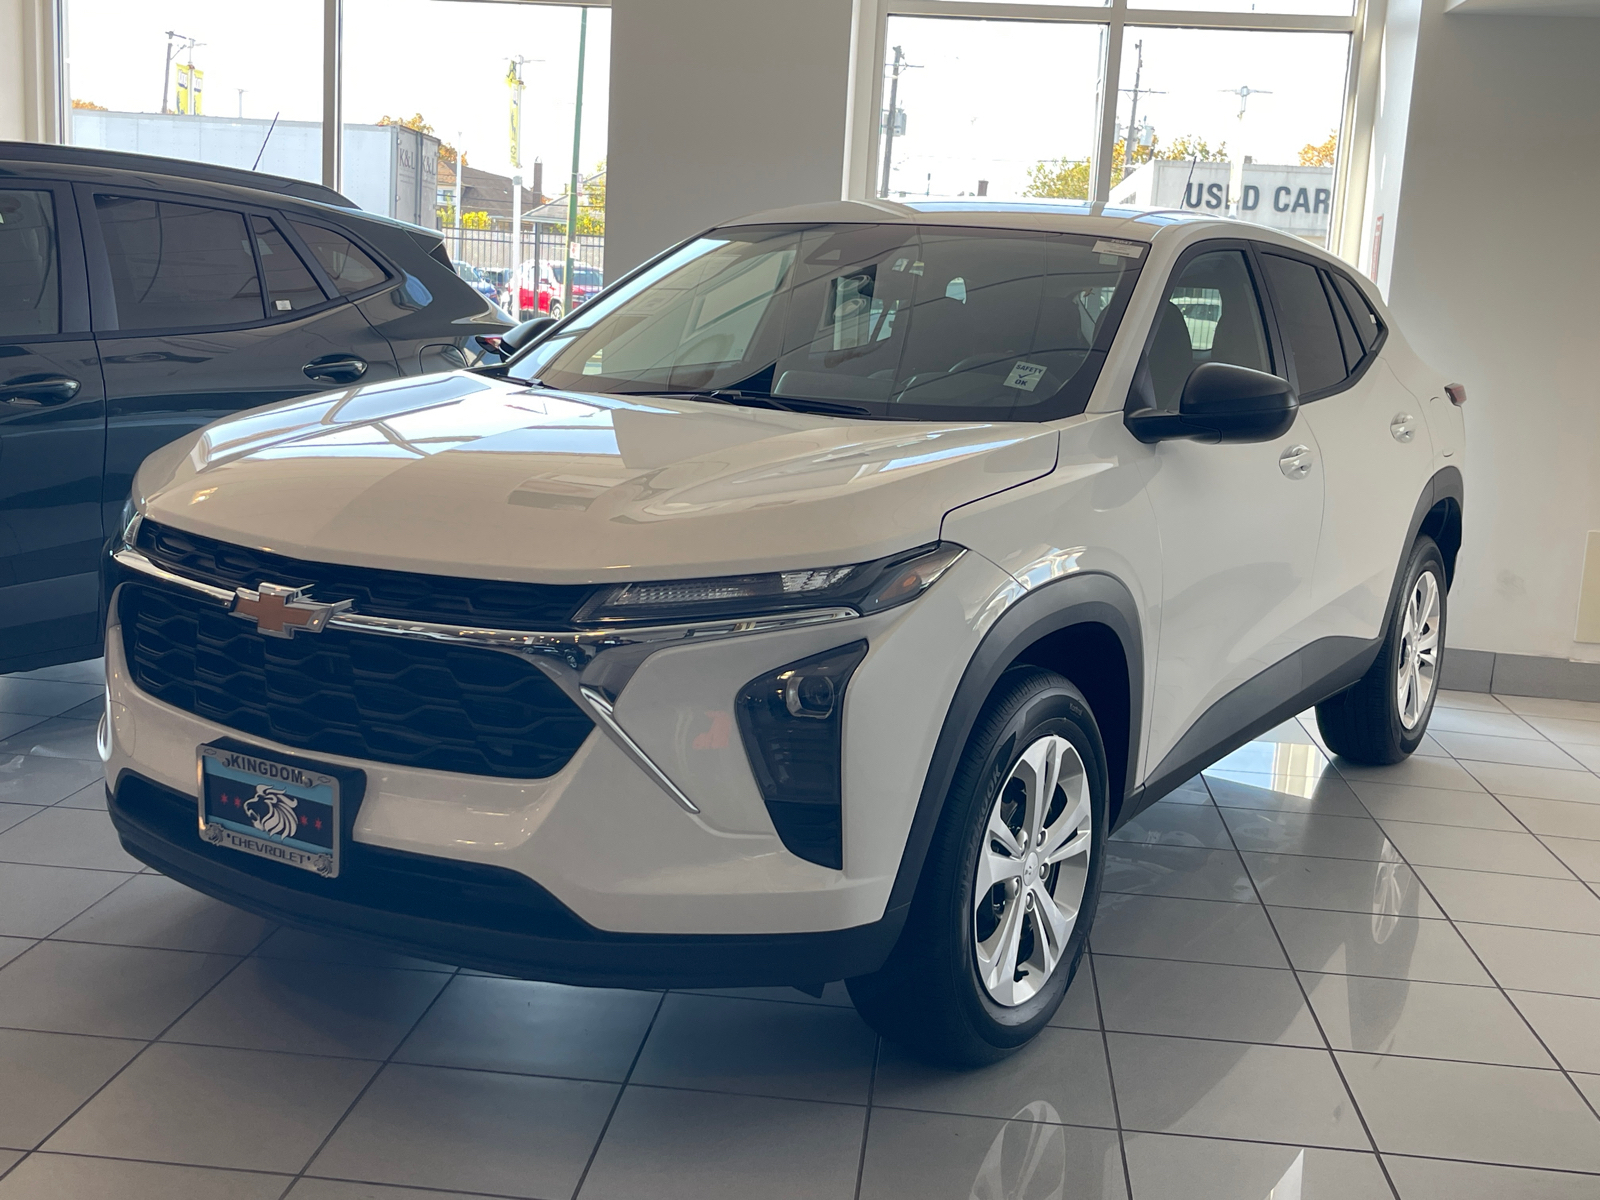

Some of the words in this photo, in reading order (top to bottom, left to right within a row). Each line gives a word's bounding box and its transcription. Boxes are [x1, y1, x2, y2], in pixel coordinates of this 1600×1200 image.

[1186, 182, 1260, 211] USD
[1273, 186, 1332, 215] CAR
[1014, 379, 1028, 387] OK
[1015, 364, 1044, 374] SAFETY
[230, 753, 304, 785] KINGDOM
[231, 834, 306, 864] CHEVROLET
